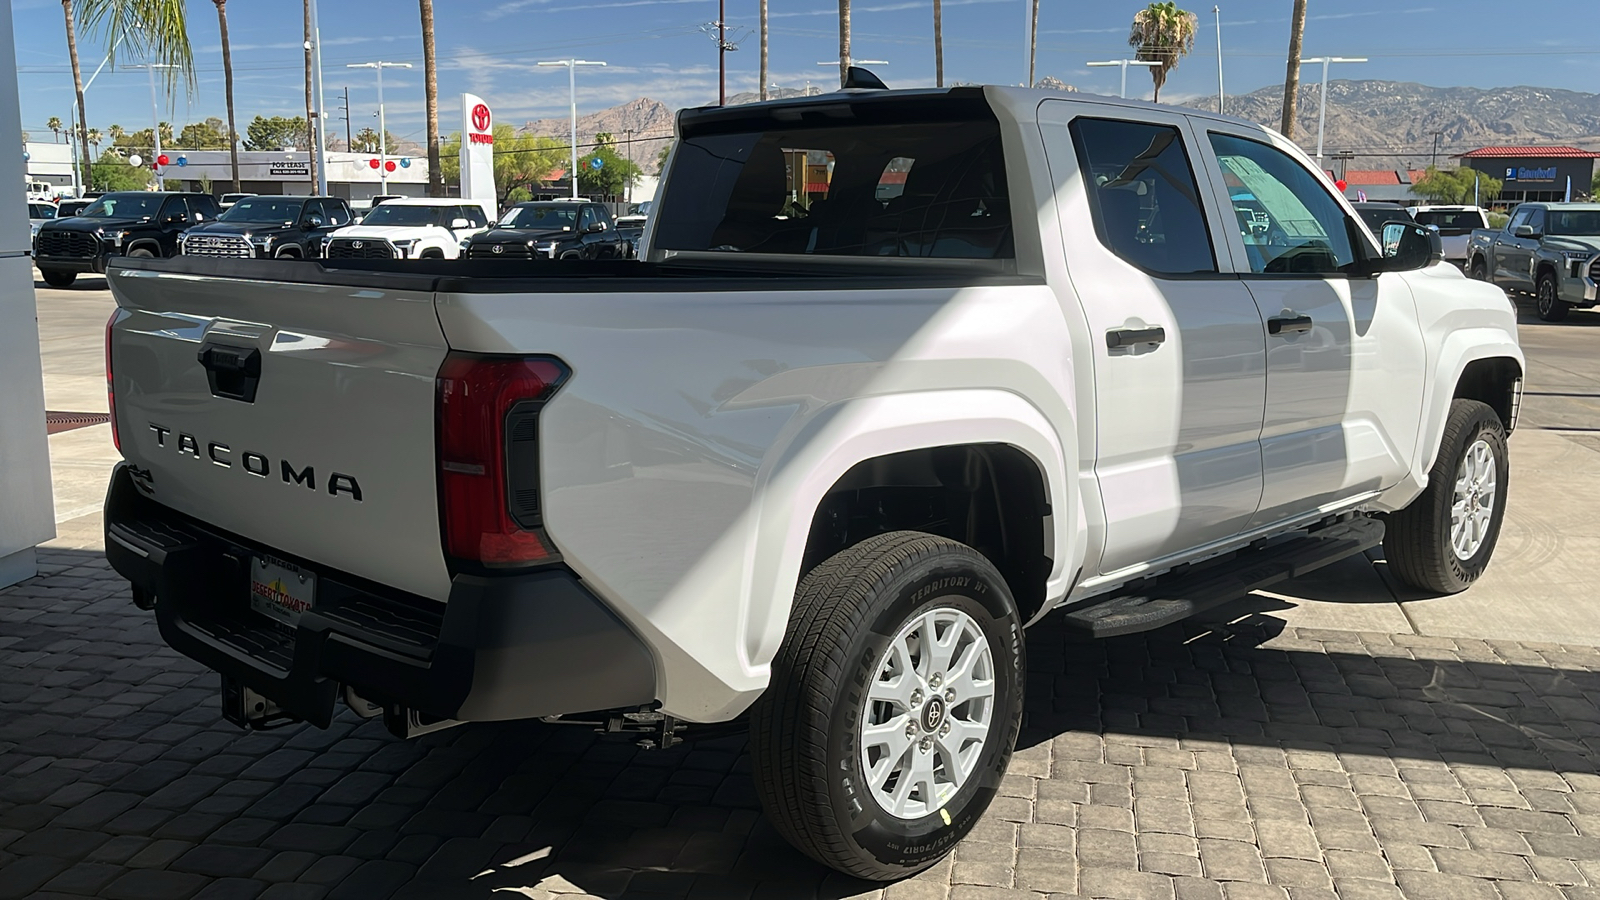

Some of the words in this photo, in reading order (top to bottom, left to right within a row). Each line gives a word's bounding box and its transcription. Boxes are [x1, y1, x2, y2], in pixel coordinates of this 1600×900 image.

[1518, 167, 1557, 179] Goodwill
[149, 421, 363, 503] TACOMA
[266, 555, 299, 573] TUCSON
[252, 580, 277, 601] DESERT
[279, 591, 312, 614] TOYOTA
[910, 577, 972, 604] TERRITORY
[974, 581, 989, 594] HT
[840, 646, 876, 821] WRANGLER
[903, 830, 955, 854] 245/70R17
